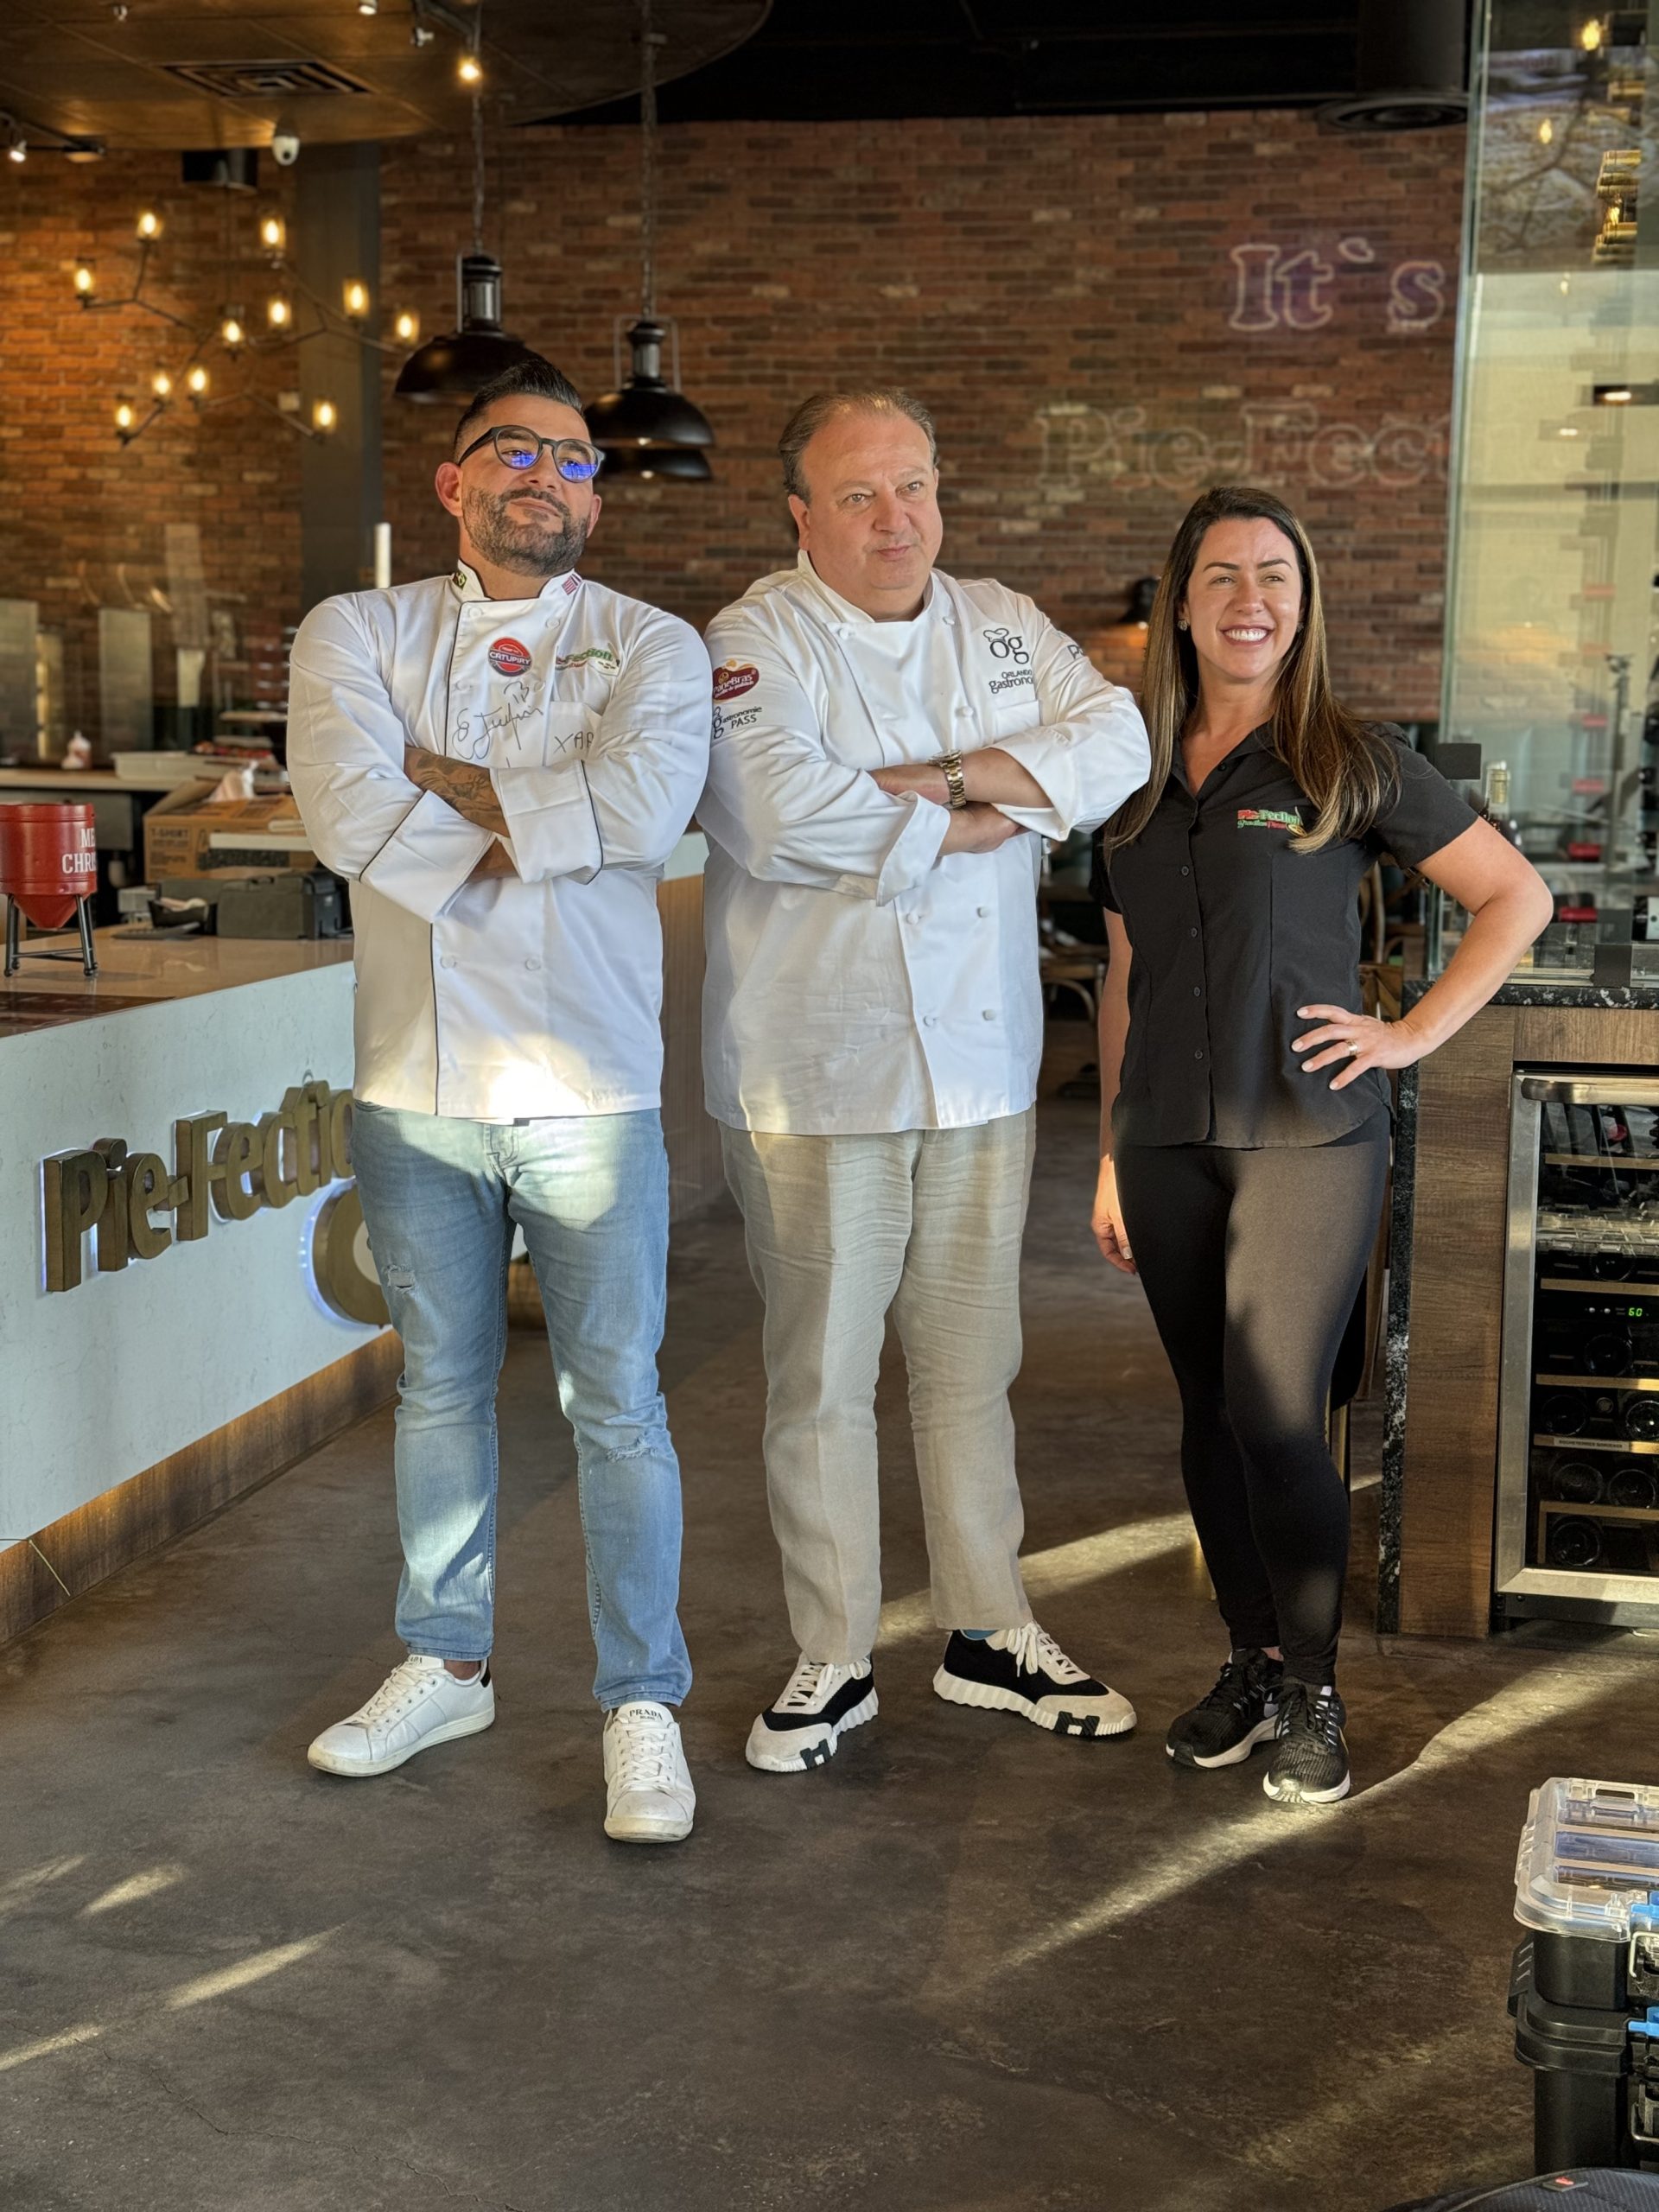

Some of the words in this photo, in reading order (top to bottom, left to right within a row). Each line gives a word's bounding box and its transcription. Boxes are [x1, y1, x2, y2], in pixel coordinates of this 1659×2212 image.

[1229, 237, 1446, 332] It's
[489, 652, 531, 664] CATUPIRY
[731, 714, 757, 729] PASS
[1629, 1307, 1643, 1317] 60
[629, 1709, 664, 1720] PRADA
